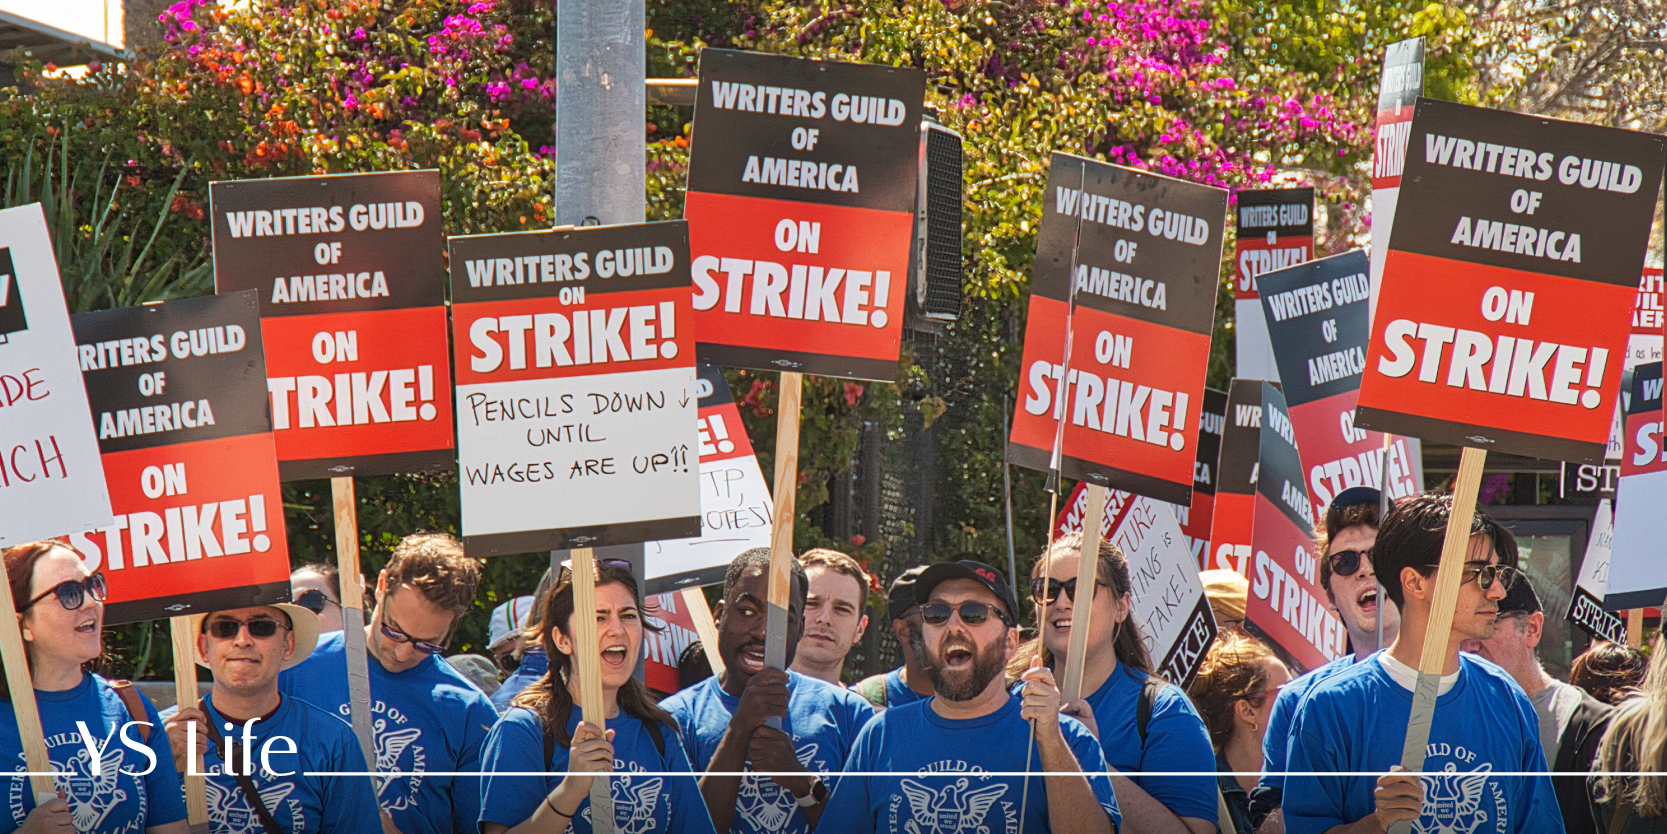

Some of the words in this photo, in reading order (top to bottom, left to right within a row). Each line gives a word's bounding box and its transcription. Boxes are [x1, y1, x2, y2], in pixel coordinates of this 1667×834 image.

[712, 80, 826, 119] WRITERS
[831, 93, 906, 126] GUILD
[792, 127, 819, 151] OF
[1376, 121, 1412, 179] STRIK
[742, 156, 859, 193] AMERICA
[1425, 133, 1554, 182] WRITERS
[1558, 156, 1643, 194] GUILD
[226, 206, 345, 238] WRITERS
[349, 201, 424, 231] GUILD
[1056, 186, 1145, 232] WRITERS
[1148, 208, 1209, 246] GUILD
[1240, 206, 1278, 228] WRITERS
[1279, 204, 1308, 226] GUILD
[1510, 188, 1543, 216] OF
[314, 242, 342, 265] OF
[774, 218, 821, 254] ON
[1114, 239, 1138, 264] OF
[1267, 231, 1276, 244] ON
[1450, 216, 1582, 264] AMERICA
[271, 271, 390, 303] AMERICA
[465, 252, 591, 288] WRITERS
[595, 246, 674, 279] GUILD
[1076, 264, 1167, 311] AMERICA
[559, 286, 585, 306] ON
[691, 255, 891, 328] STRIKE!
[1268, 281, 1332, 322] WRITERS
[1332, 272, 1370, 307] GUILD
[1481, 285, 1535, 326] ON
[78, 334, 168, 371] RITERS
[170, 324, 246, 359] GUILD
[312, 330, 358, 364] ON
[469, 301, 679, 373] STRIKE!
[1094, 330, 1133, 369] ON
[1322, 318, 1338, 343] OF
[138, 372, 166, 396] OF
[1308, 346, 1366, 386] AMERICA
[1378, 319, 1610, 410] STRIKE!
[0, 367, 50, 407] DE
[267, 365, 437, 430] TRIKE!
[1025, 360, 1189, 452] STRIKE!
[100, 399, 216, 440] AMERICA
[466, 392, 574, 426] PENCILS
[587, 390, 665, 415] DOWN
[527, 424, 606, 446] UNTIL
[0, 435, 67, 487] ICH
[141, 462, 188, 499] ON
[466, 462, 555, 486] WAGES
[569, 457, 616, 480] ARE
[700, 501, 773, 536] OTES!
[1282, 480, 1315, 528] AMER
[1116, 496, 1156, 556] TURE
[1129, 546, 1162, 612] TING
[1160, 532, 1172, 548] is
[1295, 545, 1316, 586] ON
[1140, 563, 1192, 654] STAKE!
[1253, 550, 1344, 662] STRIKE!
[388, 708, 408, 725] OF
[10, 765, 28, 826] RITERS
[44, 732, 81, 750] UILD
[890, 794, 902, 834] TERS
[917, 760, 968, 779] GUILD
[1426, 743, 1451, 758] ILD
[1455, 746, 1476, 764] OF
[1489, 782, 1507, 834] AMERI
